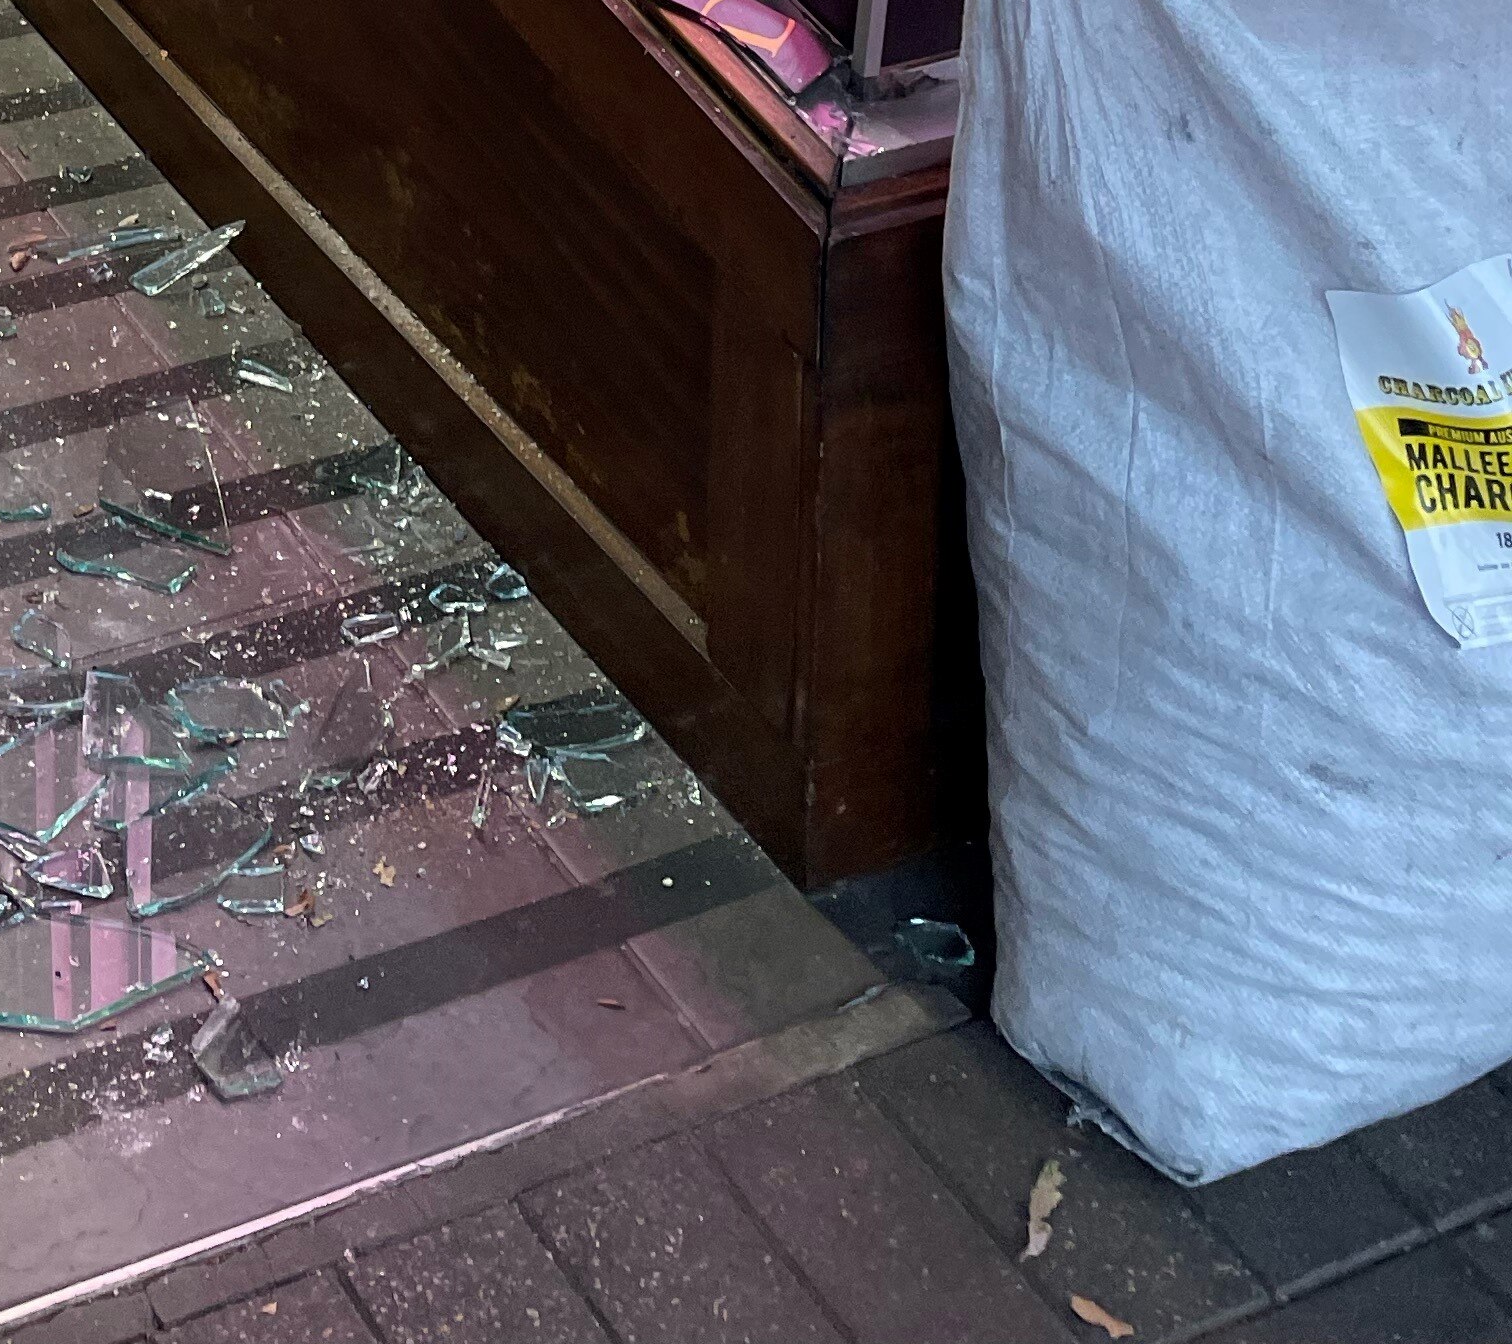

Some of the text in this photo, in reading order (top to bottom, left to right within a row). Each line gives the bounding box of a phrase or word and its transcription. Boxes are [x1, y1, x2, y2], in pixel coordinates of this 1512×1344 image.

[1377, 374, 1502, 408] CHARCOAL
[1428, 421, 1486, 446] PREMIUM
[1404, 441, 1511, 476] MALLEE
[1415, 472, 1512, 514] CHAR
